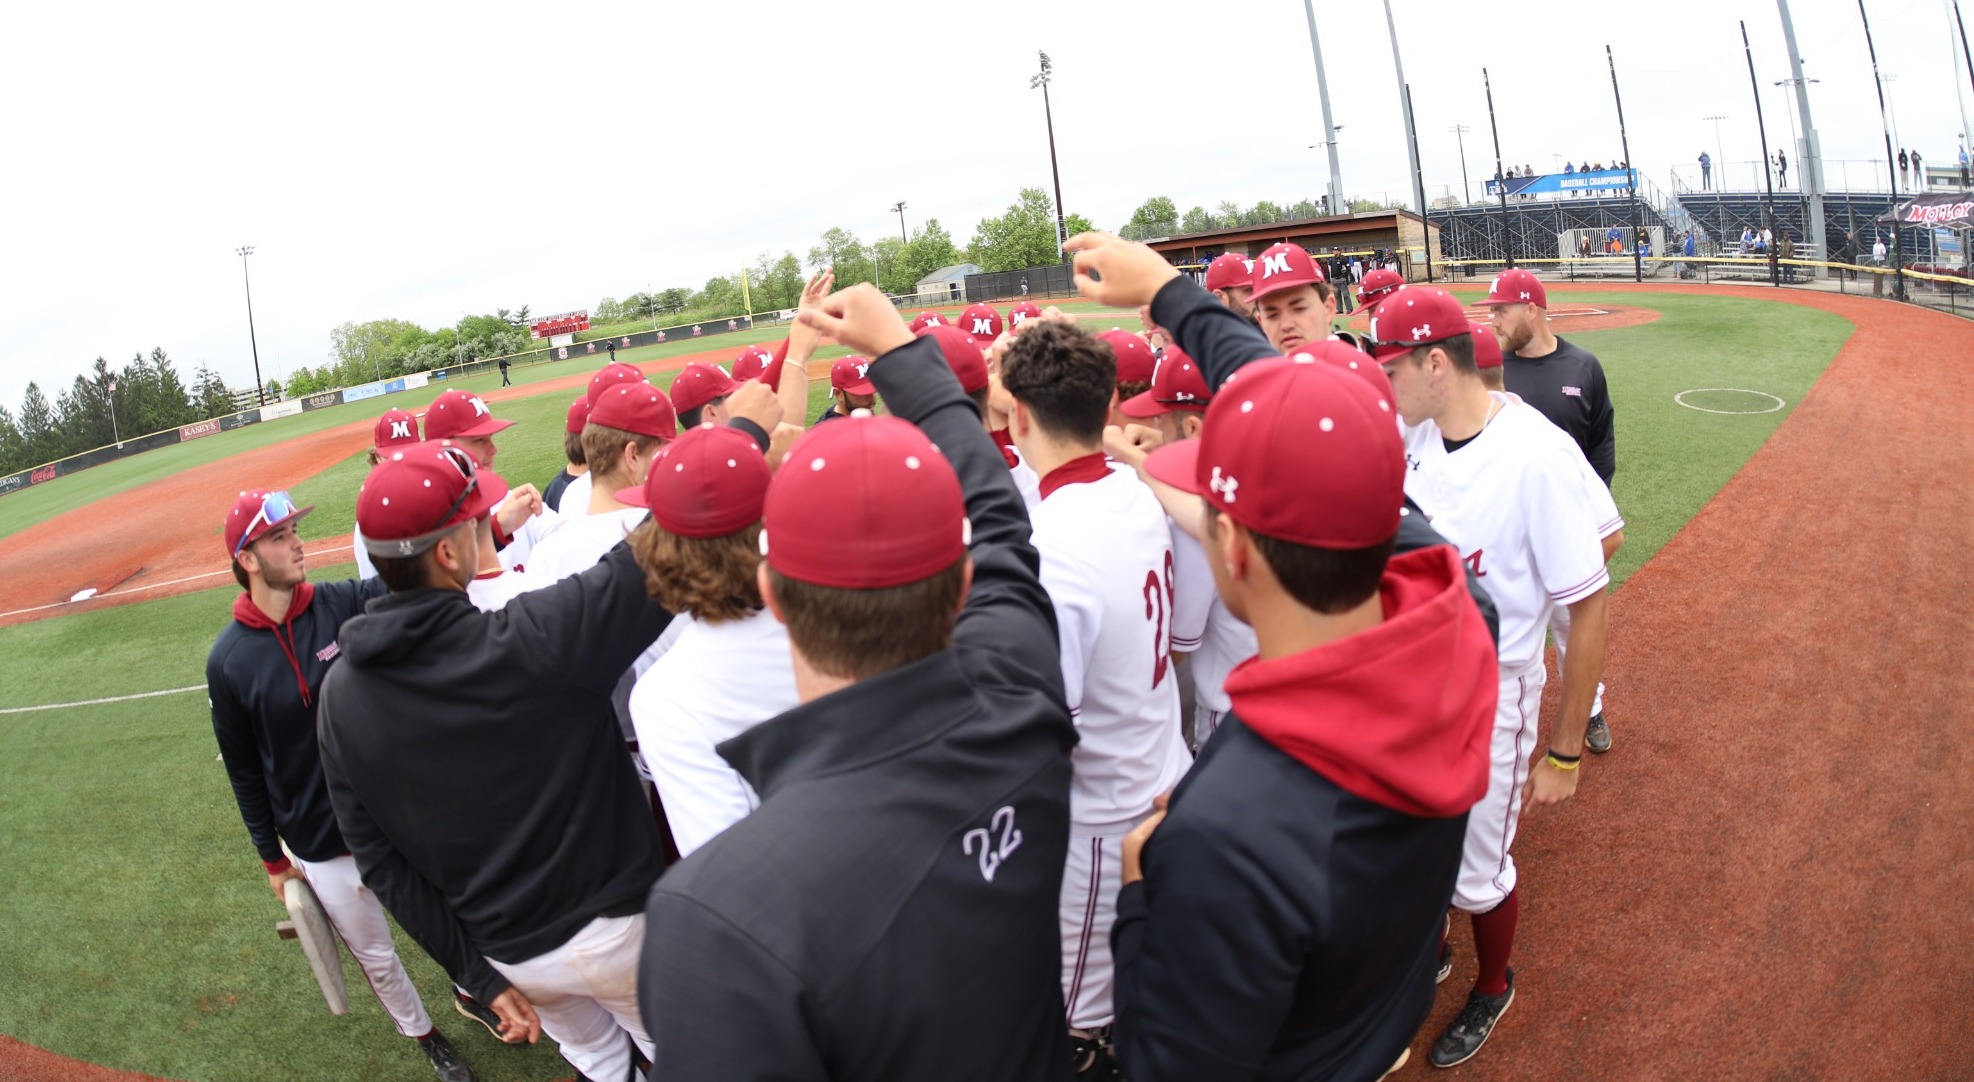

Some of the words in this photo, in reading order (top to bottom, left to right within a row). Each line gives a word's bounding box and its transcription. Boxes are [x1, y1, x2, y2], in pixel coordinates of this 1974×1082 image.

[1560, 178, 1588, 188] BASEBALL
[1905, 202, 1974, 222] MOLLOY
[1262, 252, 1293, 279] M
[971, 318, 993, 335] M
[184, 422, 216, 437] KASEY'S
[391, 420, 411, 439] M
[963, 805, 1023, 882] 22
